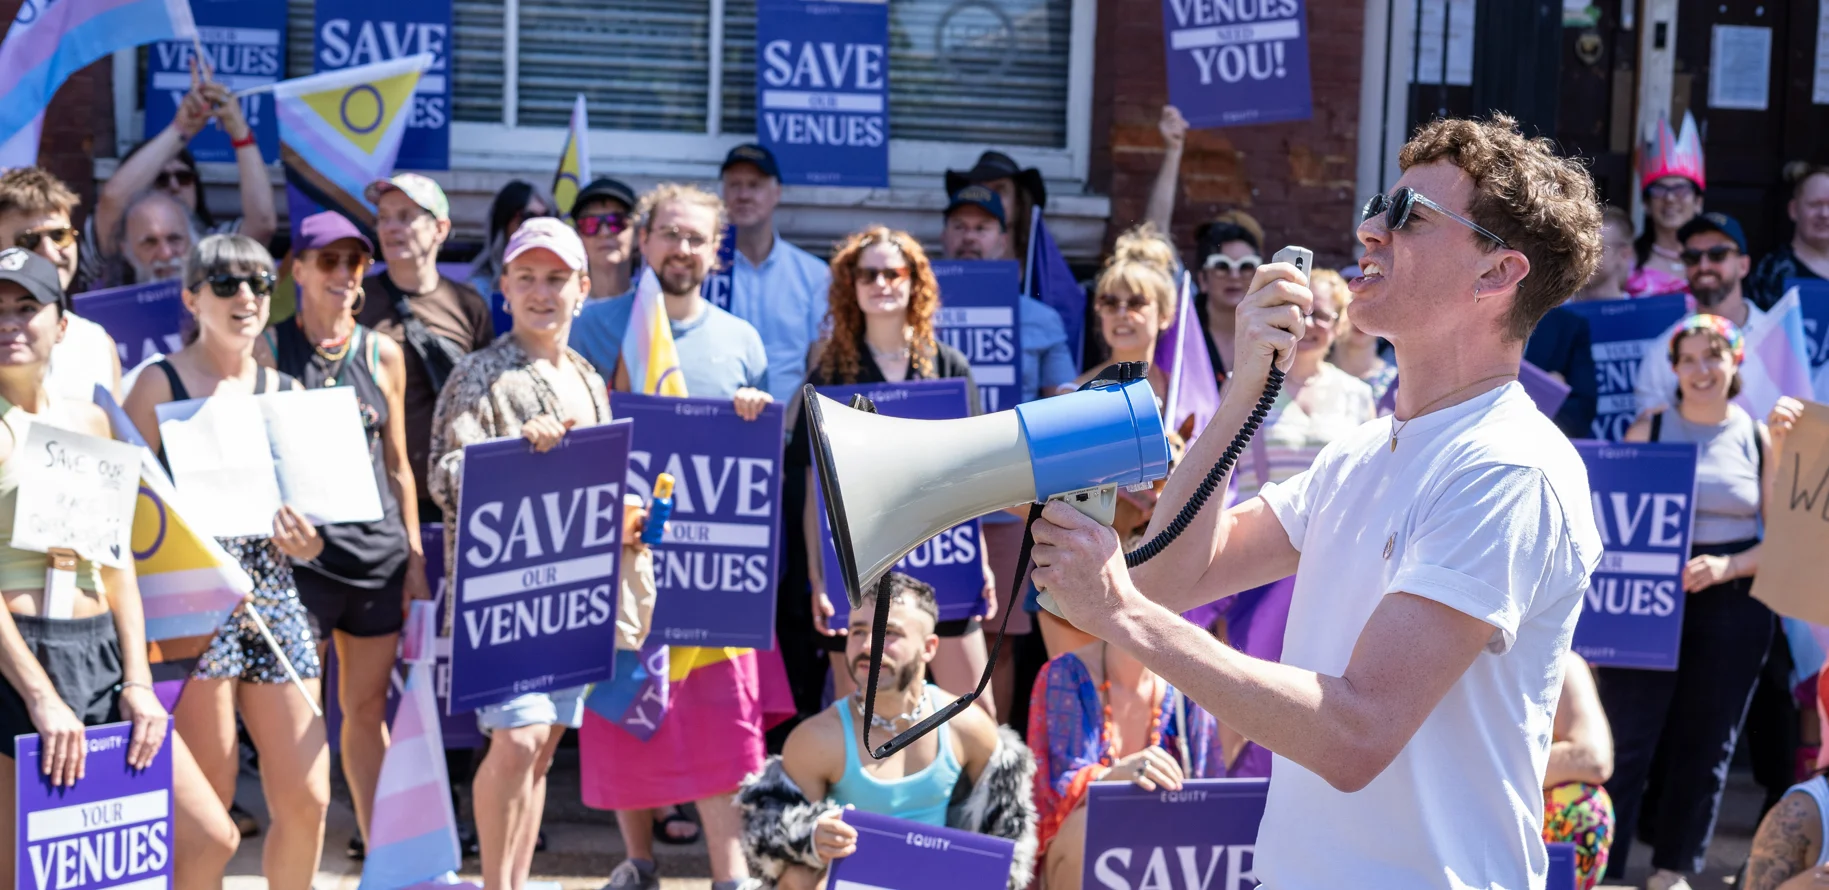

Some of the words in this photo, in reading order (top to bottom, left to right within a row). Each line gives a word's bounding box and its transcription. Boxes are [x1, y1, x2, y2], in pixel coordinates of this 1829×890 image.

[320, 18, 447, 70] SAVE
[763, 39, 884, 89] SAVE
[1190, 41, 1287, 85] YOU!
[764, 112, 884, 148] VENUES
[675, 402, 720, 416] EQUITY
[465, 482, 619, 569] SAVE
[672, 524, 710, 542] OUR
[1592, 491, 1687, 547] AVE
[522, 566, 557, 588] OUR
[1582, 577, 1677, 616] NUES
[463, 584, 611, 650] VENUES
[664, 627, 709, 640] EQUITY
[513, 674, 555, 692] EQUITY
[1160, 789, 1209, 803] EQUITY
[81, 802, 123, 828] YOUR
[27, 821, 168, 890] VENUES
[906, 831, 951, 851] EQUITY
